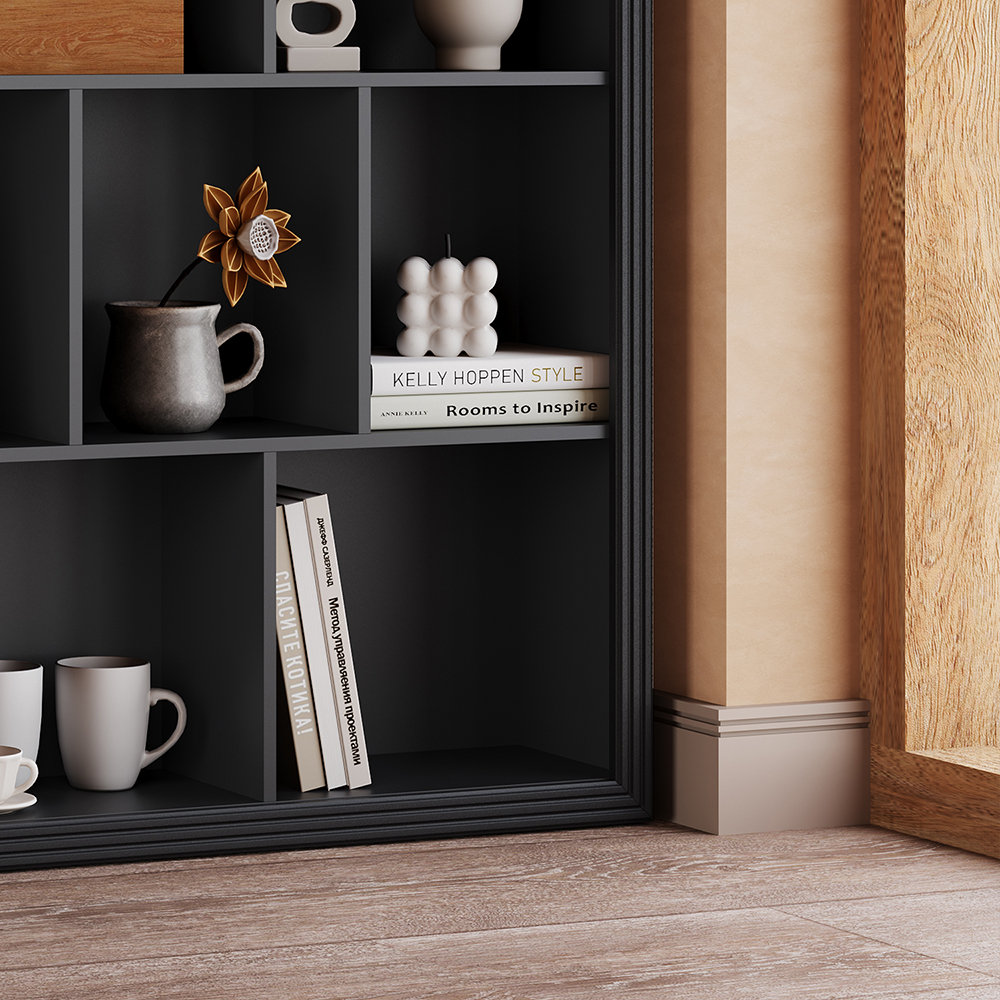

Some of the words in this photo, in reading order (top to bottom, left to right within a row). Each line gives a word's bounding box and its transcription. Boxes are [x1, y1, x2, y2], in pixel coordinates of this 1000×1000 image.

[393, 371, 448, 387] KELLY
[454, 368, 524, 385] HOPPEN
[531, 366, 584, 383] STYLE
[446, 404, 507, 417] Rooms
[513, 403, 531, 414] to
[538, 400, 598, 416] Inspire
[316, 518, 328, 546] ДЖЕФФ
[322, 546, 334, 587] САЗЕРЛЕНД
[285, 656, 314, 736] КОТИКА!
[329, 597, 340, 634] Метод
[344, 706, 362, 766] проектами
